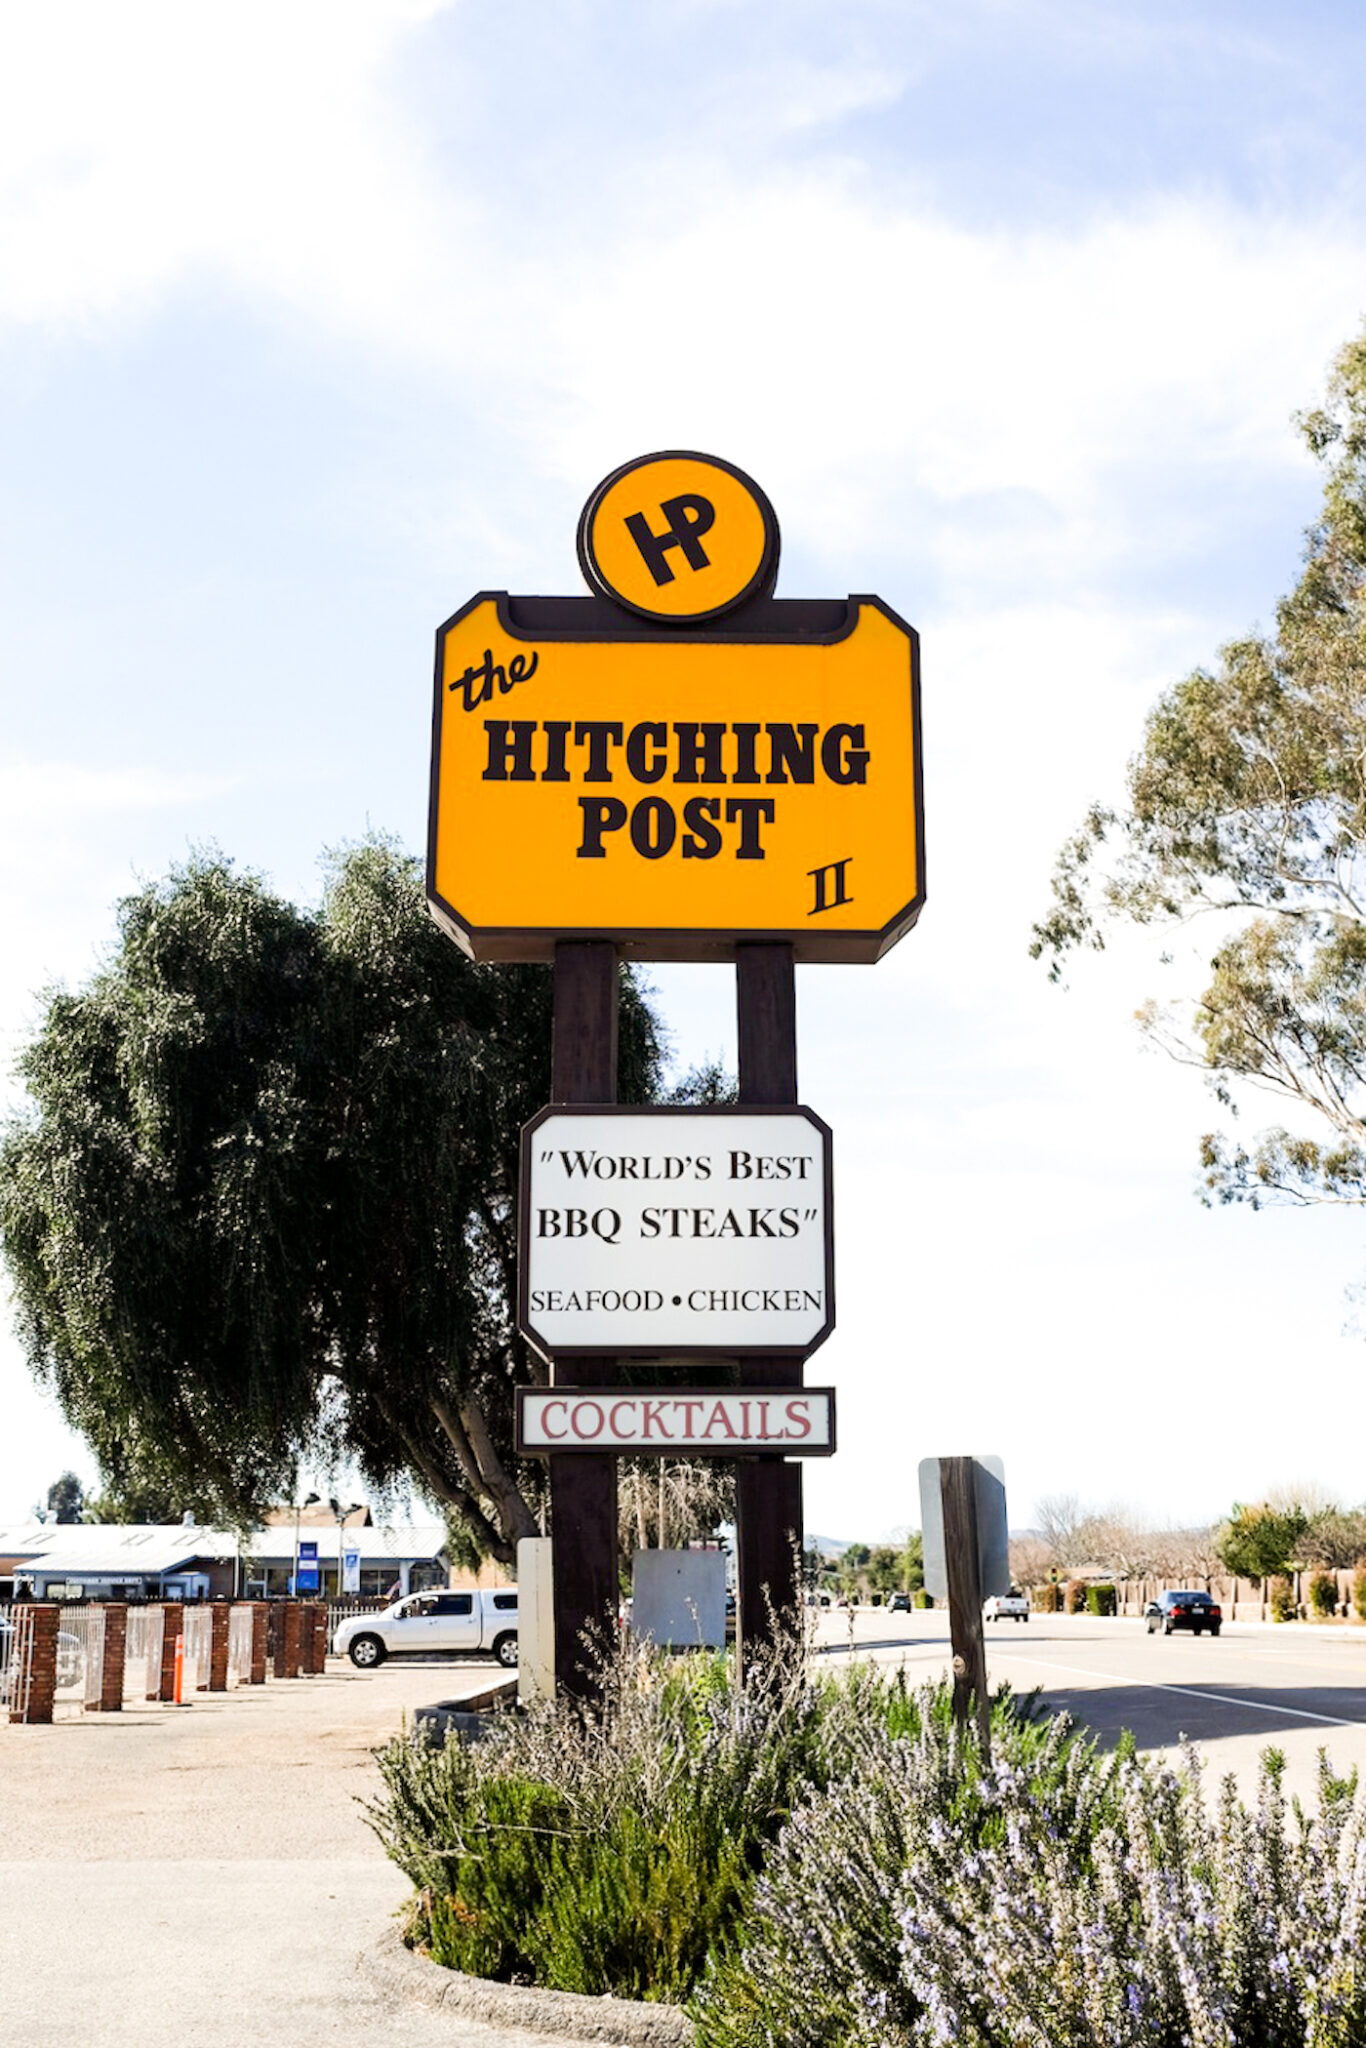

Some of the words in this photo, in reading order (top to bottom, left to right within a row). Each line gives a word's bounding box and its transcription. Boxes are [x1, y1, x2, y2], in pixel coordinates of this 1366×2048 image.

[624, 493, 716, 587] HP
[449, 649, 538, 712] the
[482, 720, 870, 785] HITCHING
[576, 796, 775, 860] POST
[807, 858, 854, 916] II
[536, 1207, 622, 1244] BBQ
[640, 1207, 818, 1238] STEAKS"
[687, 1289, 823, 1312] CHICKEN
[540, 1401, 812, 1440] COCKTAILS
